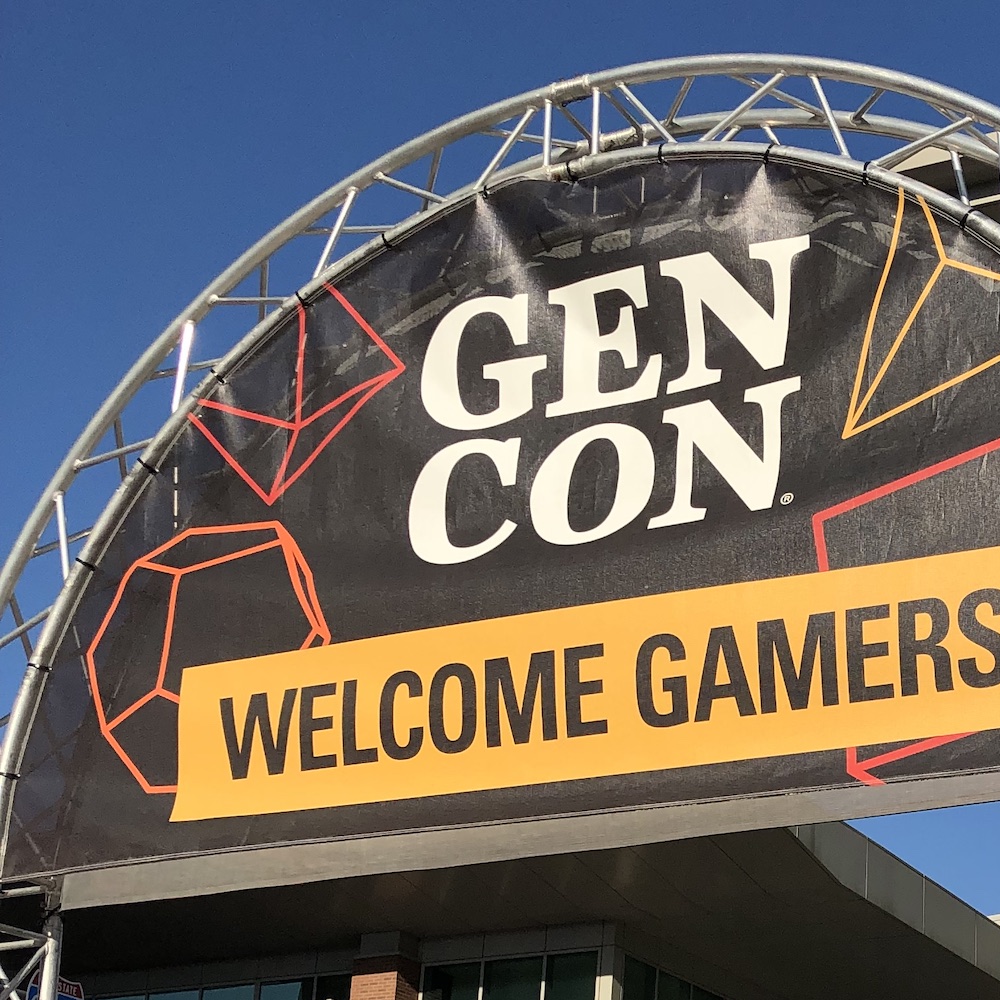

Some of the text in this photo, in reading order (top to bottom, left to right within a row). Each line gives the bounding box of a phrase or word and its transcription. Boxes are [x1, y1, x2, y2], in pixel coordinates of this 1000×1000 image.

[420, 234, 810, 431] GEN
[408, 375, 801, 565] CON
[219, 643, 608, 780] WELCOME
